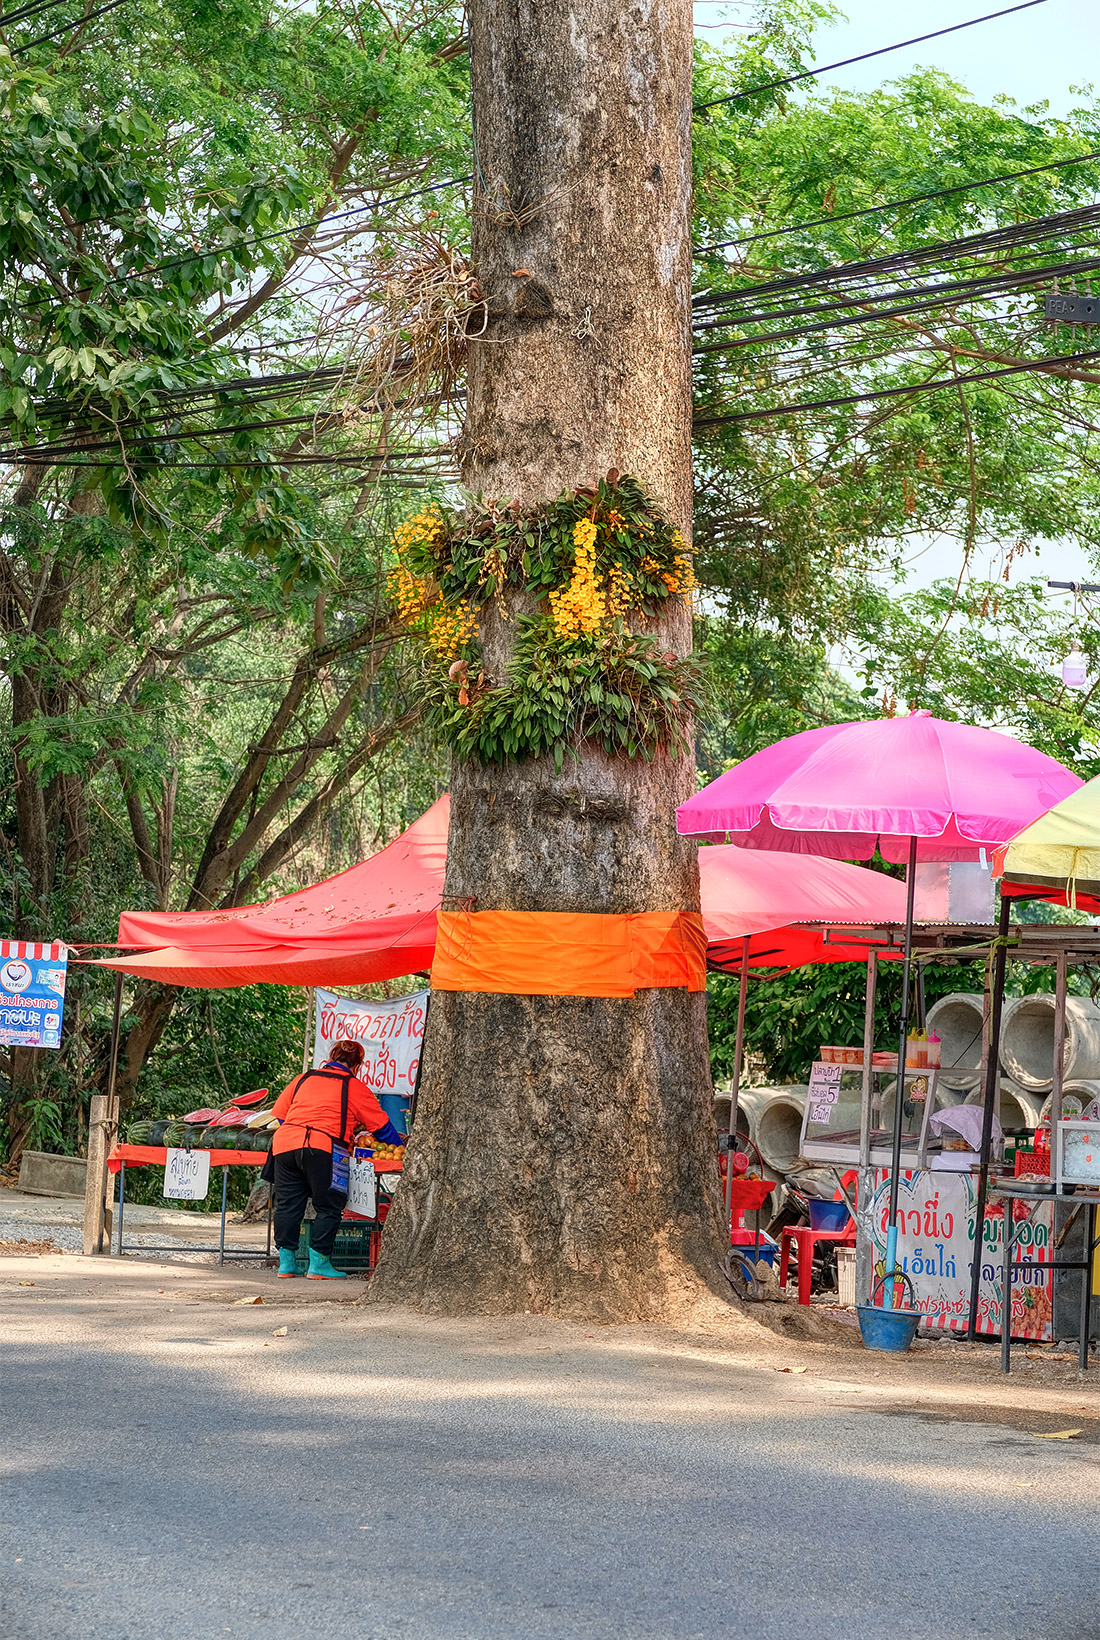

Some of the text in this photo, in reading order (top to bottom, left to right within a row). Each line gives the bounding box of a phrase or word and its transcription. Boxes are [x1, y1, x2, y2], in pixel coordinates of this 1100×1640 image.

[0, 993, 58, 1009] ่วมโครงการ
[903, 1244, 956, 1278] เอ็นไก่
[968, 1256, 1044, 1286] ลายปีก
